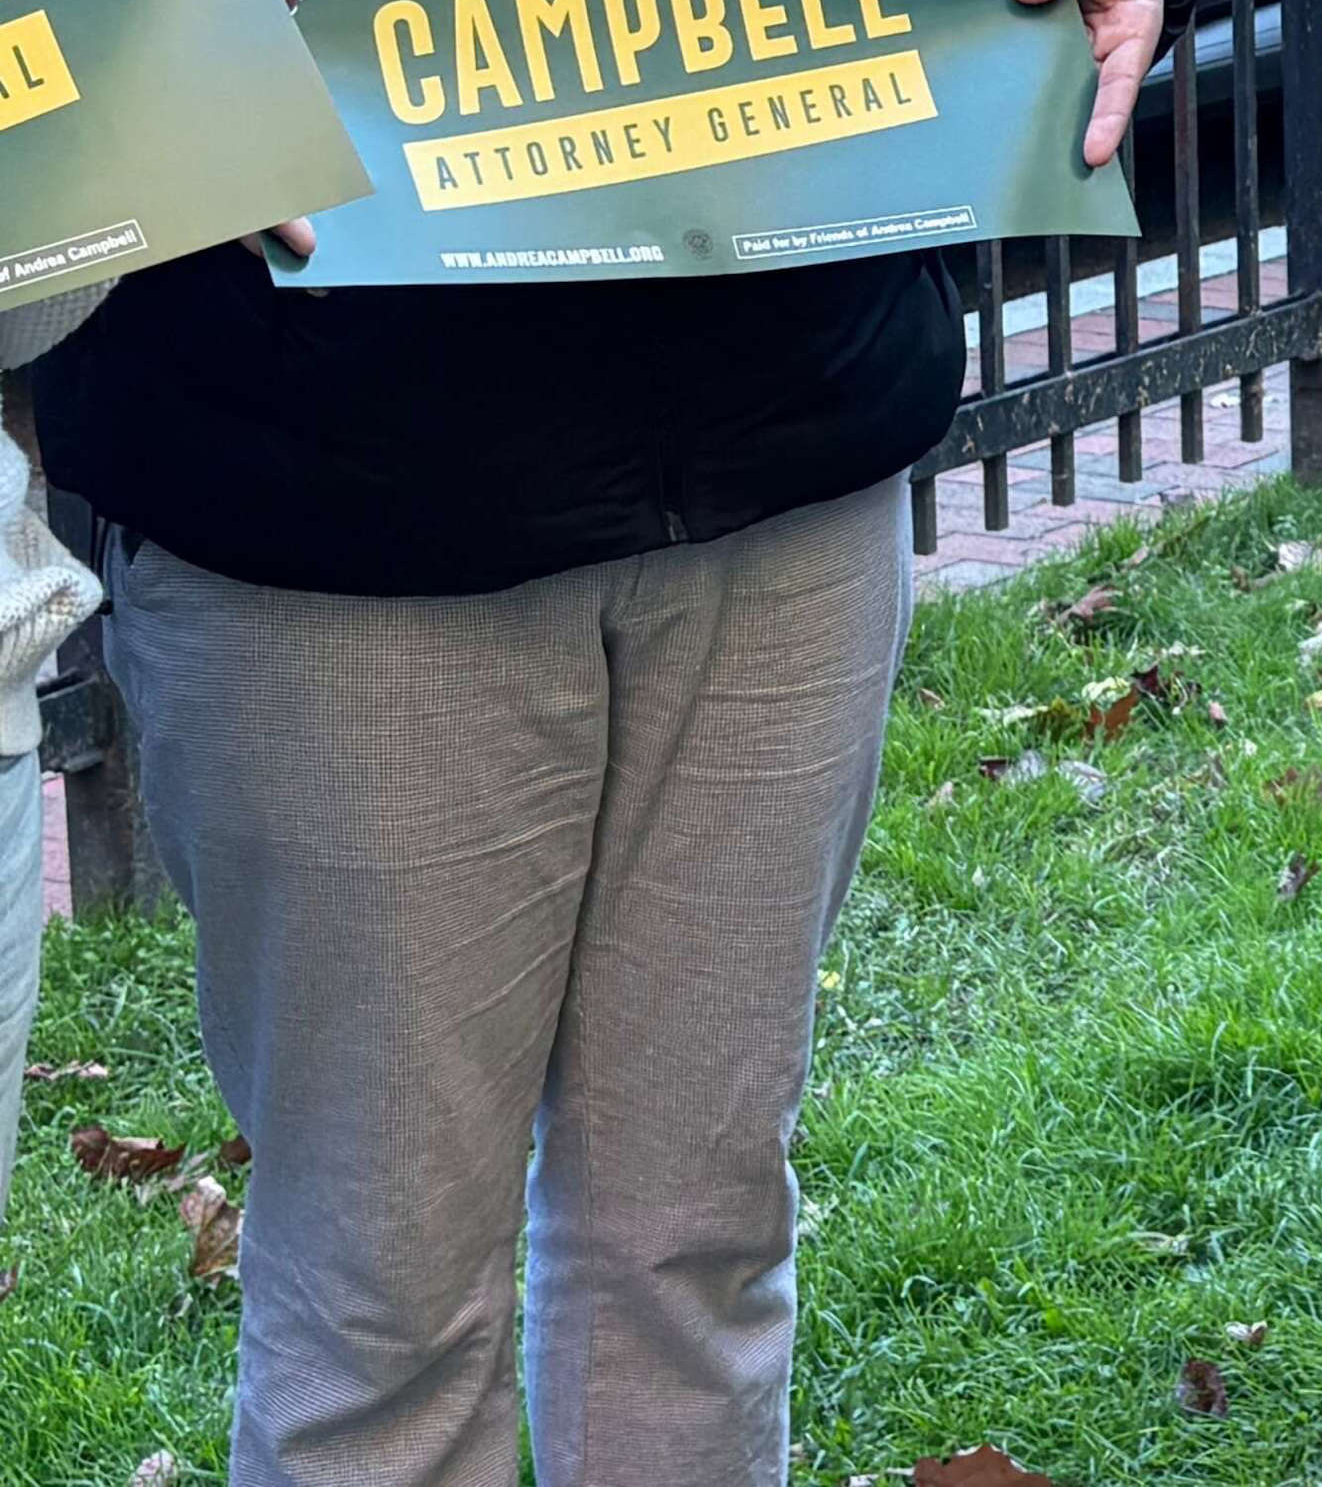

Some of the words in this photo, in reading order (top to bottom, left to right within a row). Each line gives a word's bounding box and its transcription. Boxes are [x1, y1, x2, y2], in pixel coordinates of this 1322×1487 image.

[435, 116, 673, 191] ATTORNEY
[707, 71, 912, 144] GENERAL
[14, 253, 67, 278] Andrea
[67, 228, 138, 261] Campbell
[441, 246, 663, 267] WWW.ANDREACAMPBELL.ORG
